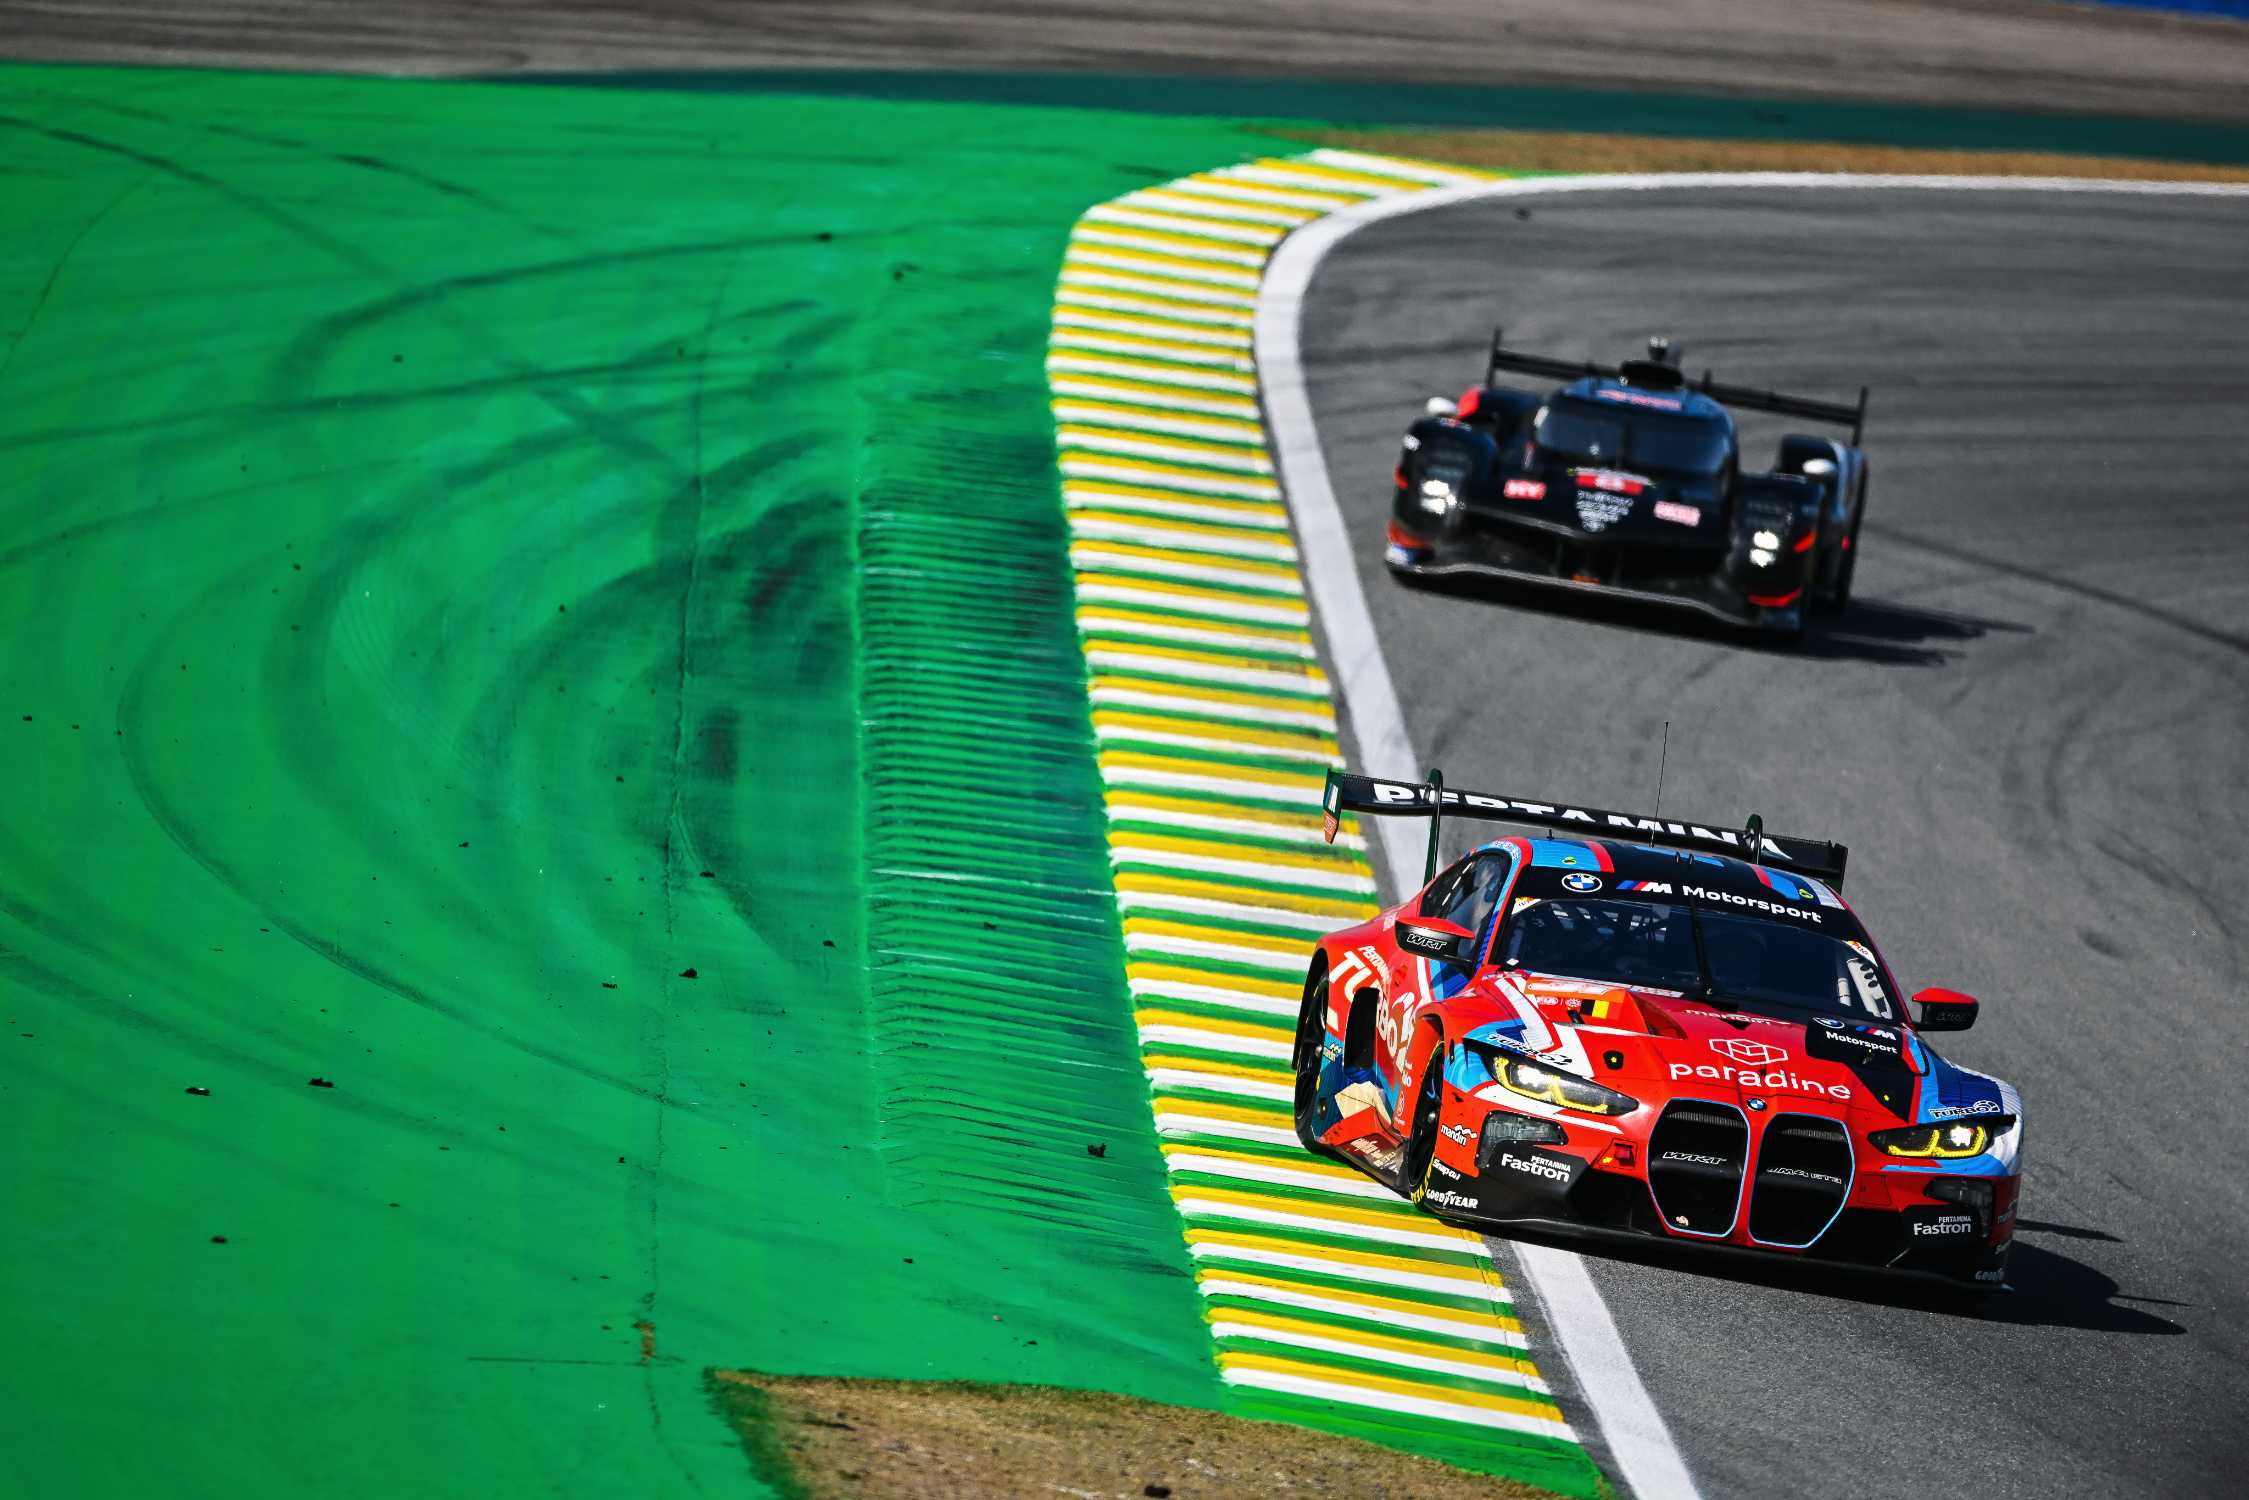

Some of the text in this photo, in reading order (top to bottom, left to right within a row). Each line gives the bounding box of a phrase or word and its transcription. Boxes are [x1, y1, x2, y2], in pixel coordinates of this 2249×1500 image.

[1682, 884, 1823, 925] Motorsport
[1406, 933, 1448, 951] WRT
[1825, 1030, 1898, 1055] Motorsport
[1669, 1062, 1852, 1100] paradine
[1530, 1155, 1572, 1173] PERTAMINA
[1662, 1151, 1728, 1165] WRT
[1501, 1153, 1570, 1183] Fastron
[1938, 1215, 1972, 1224] PERTAMINA
[1913, 1222, 1972, 1236] Fastron
